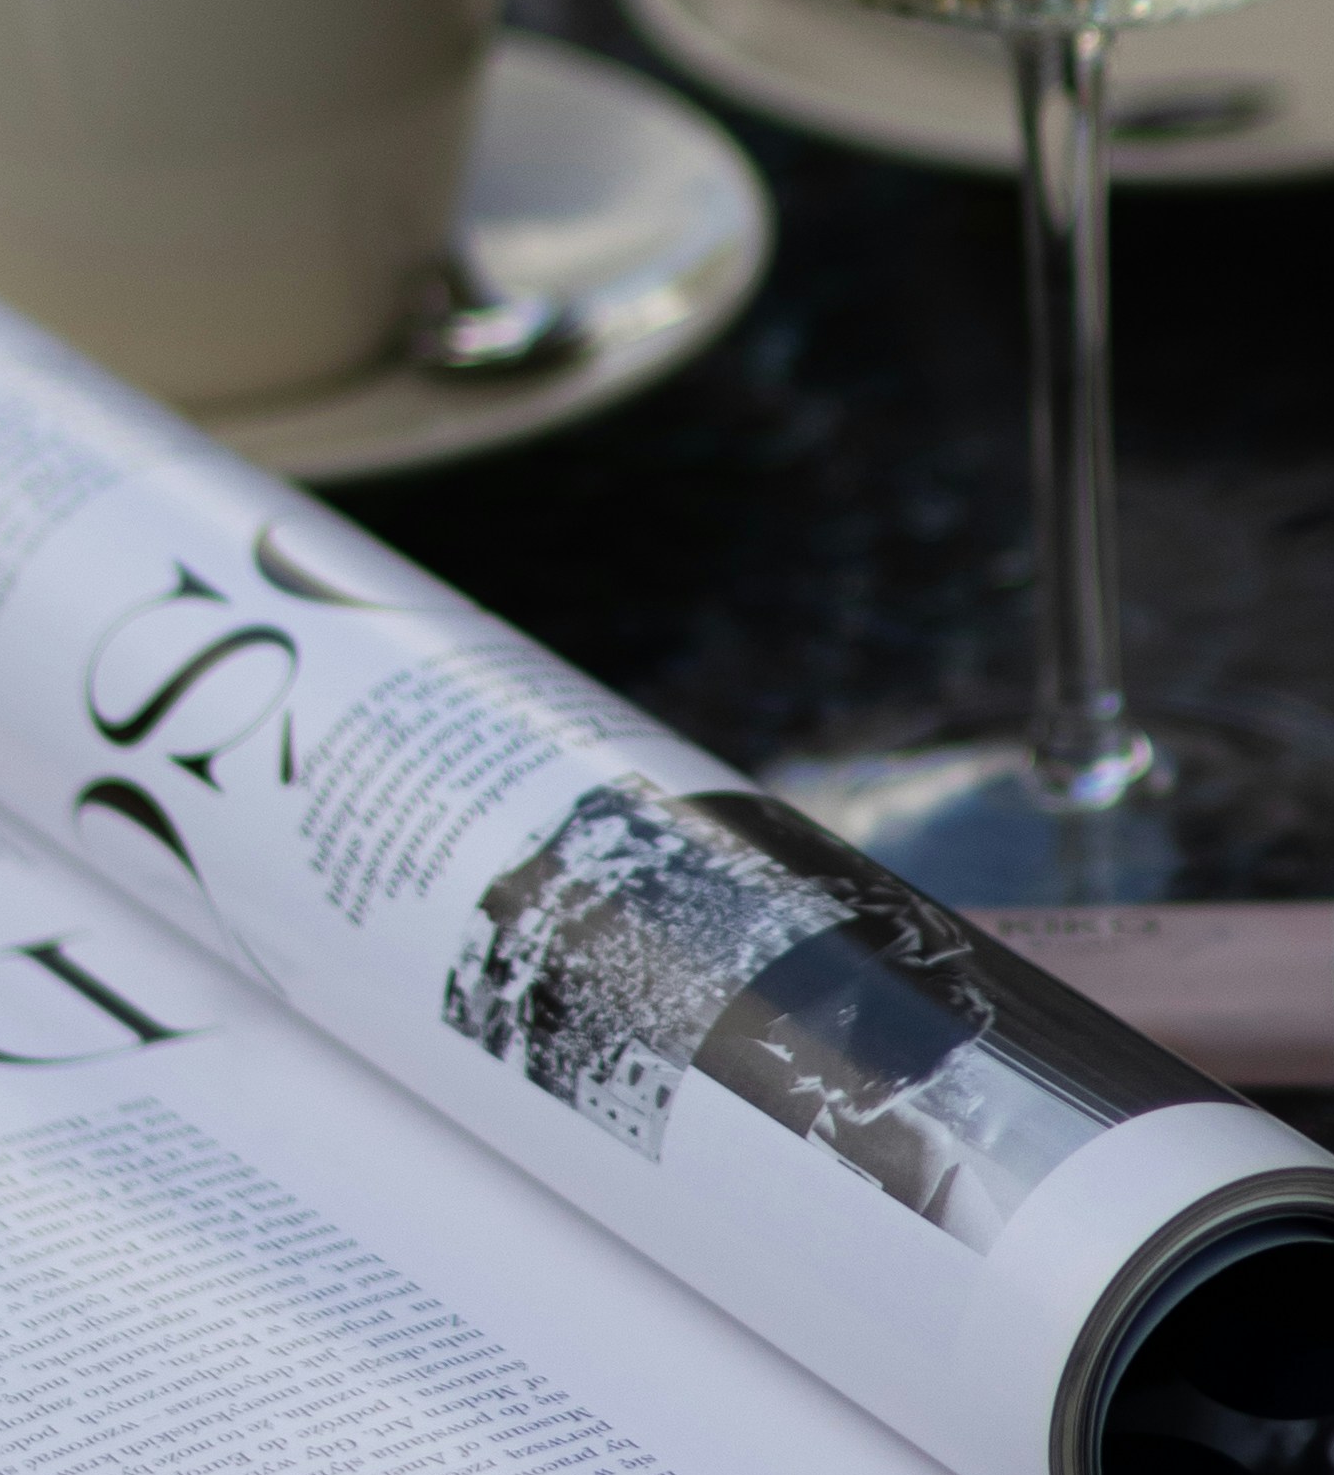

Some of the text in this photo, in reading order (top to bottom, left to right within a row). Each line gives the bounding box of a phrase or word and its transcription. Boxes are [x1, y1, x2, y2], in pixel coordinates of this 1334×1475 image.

[530, 1389, 570, 1405] się
[498, 1402, 530, 1416] do
[485, 1406, 596, 1442] Museum
[368, 1410, 495, 1459] powstania
[502, 1419, 614, 1459] pierwszą
[453, 1441, 481, 1458] of
[605, 1437, 641, 1453] by
[616, 1453, 657, 1469] się
